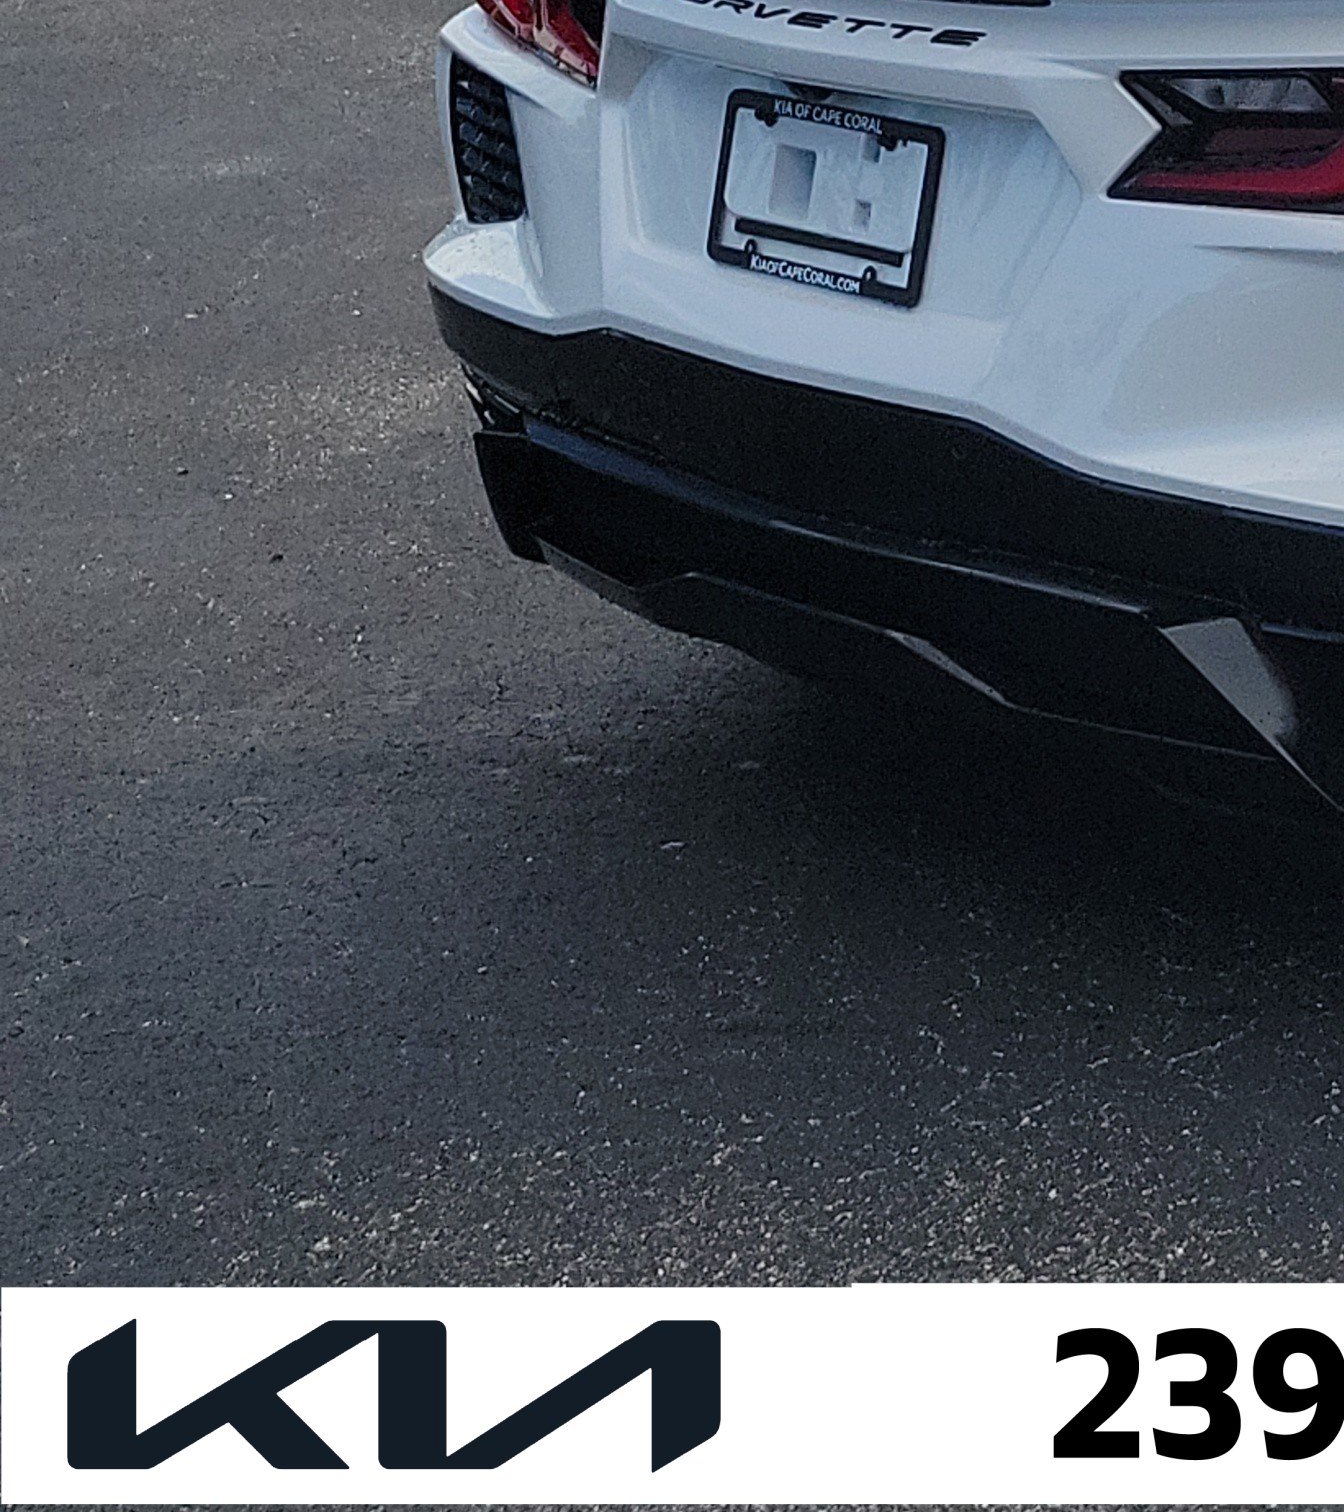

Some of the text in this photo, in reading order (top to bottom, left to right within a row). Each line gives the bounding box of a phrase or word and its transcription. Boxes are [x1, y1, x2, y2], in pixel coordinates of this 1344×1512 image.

[773, 98, 883, 135] KIA OF CAPE CORAL
